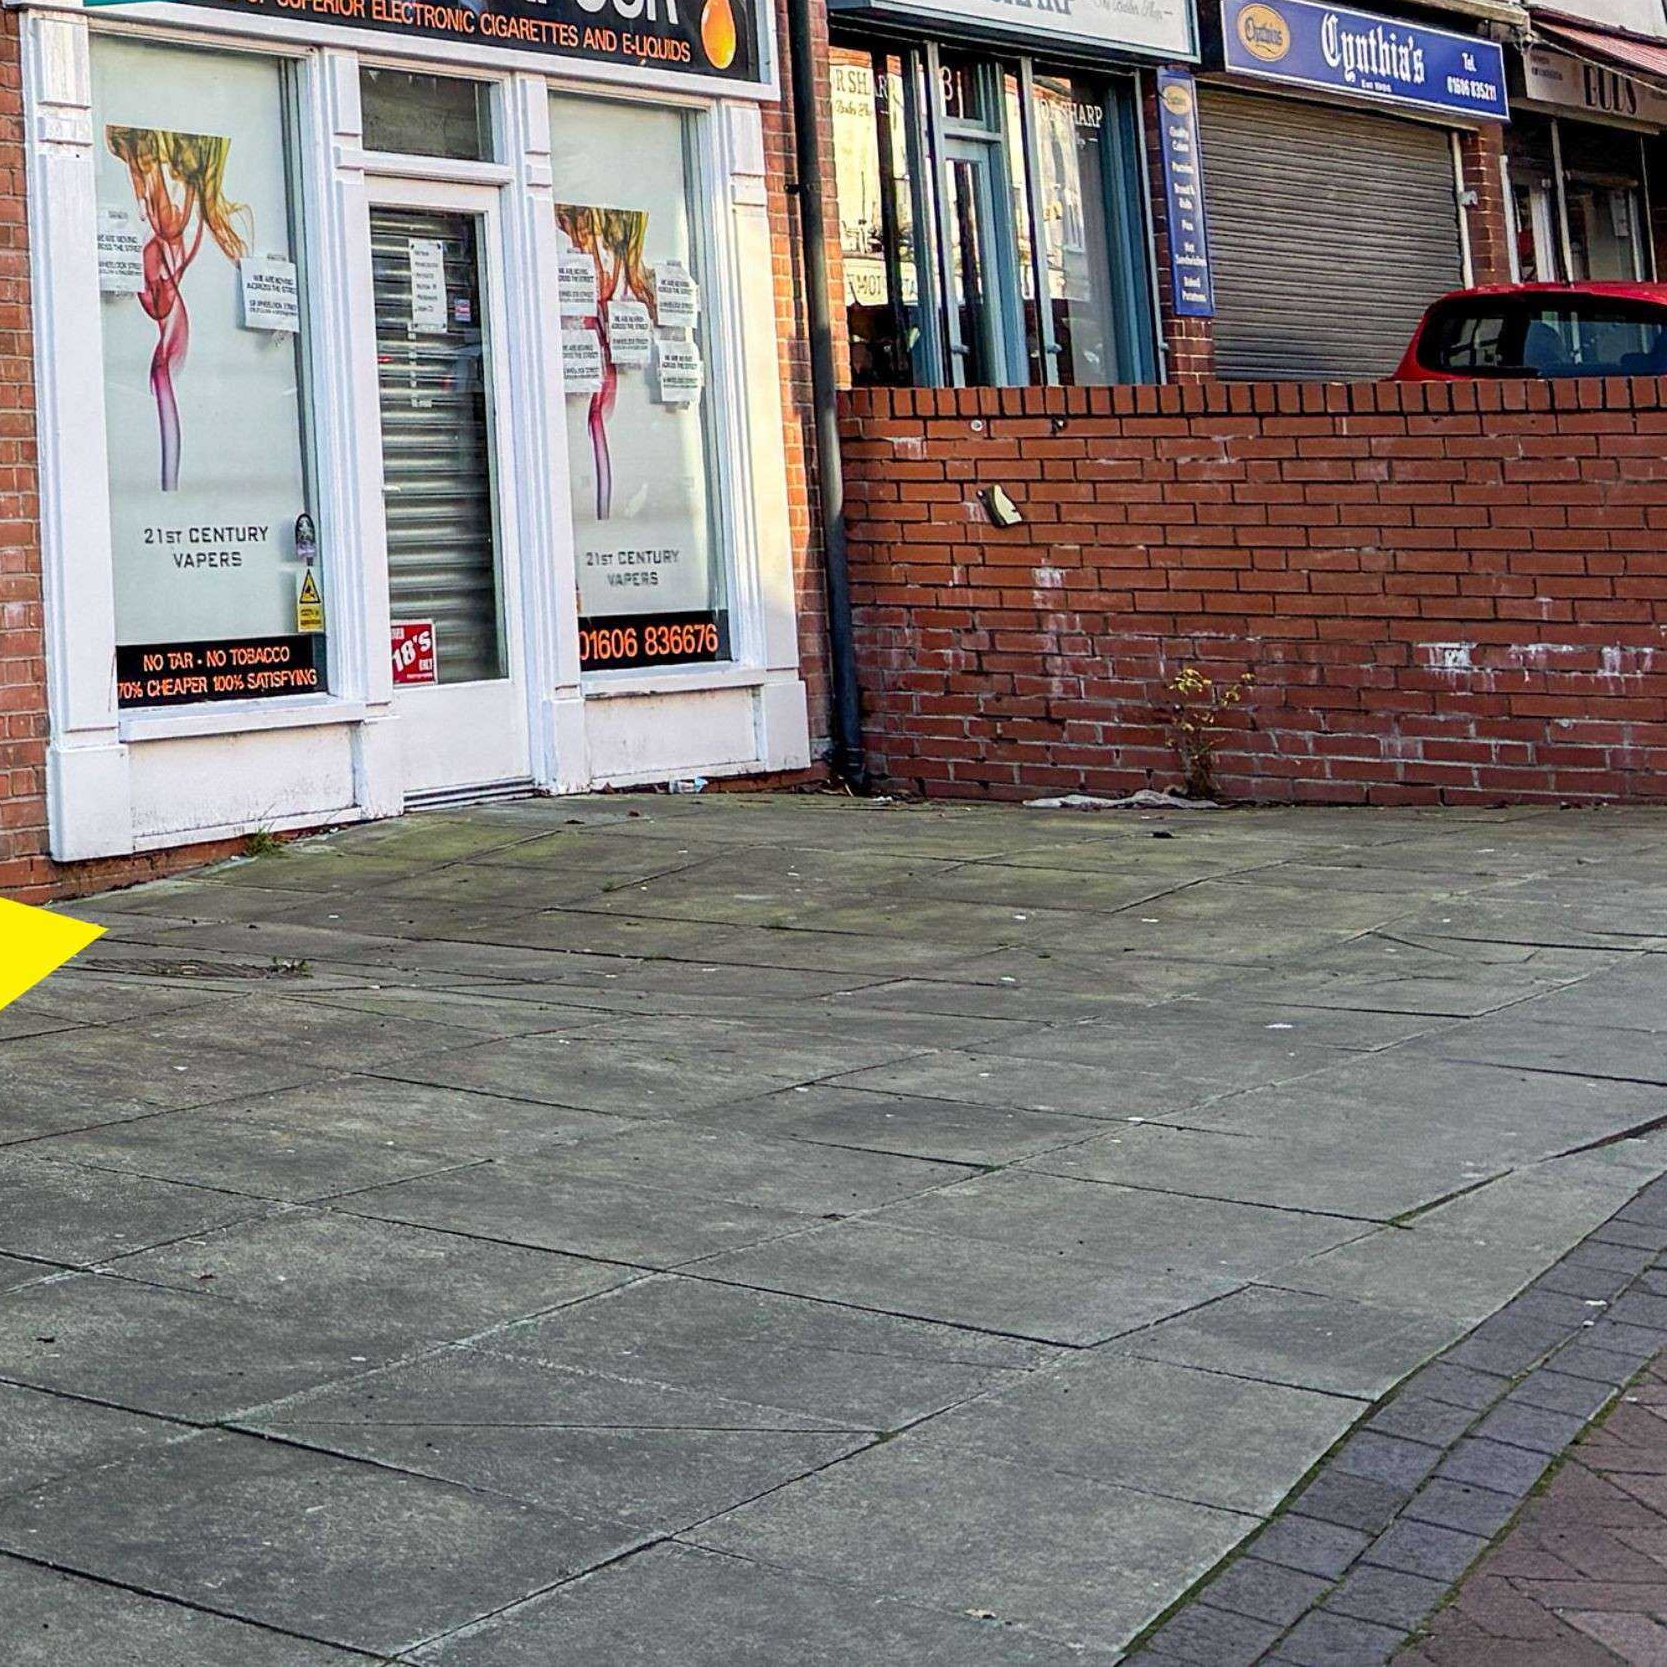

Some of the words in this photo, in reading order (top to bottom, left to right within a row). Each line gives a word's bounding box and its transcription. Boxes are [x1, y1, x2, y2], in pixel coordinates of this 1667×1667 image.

[480, 12, 579, 48] CIGARETTES
[583, 26, 618, 54] AND
[622, 31, 691, 64] E-LIQUIDS
[1320, 12, 1425, 85] Cynthia's
[189, 526, 269, 543] CENTURY
[173, 551, 242, 569] VAPERS
[618, 550, 680, 565] CENTURY
[607, 571, 659, 586] VAPERS
[393, 630, 432, 672] 18'S
[579, 627, 639, 661] 01606
[644, 623, 719, 656] 836676
[143, 654, 164, 672] NO
[167, 652, 194, 670] TAR
[206, 649, 227, 667] NO
[229, 646, 291, 666] TOBACCO
[118, 680, 144, 700] 70%
[147, 676, 208, 697] CHEAPER
[212, 674, 244, 692] 100%
[247, 668, 319, 688] SATISFYING
